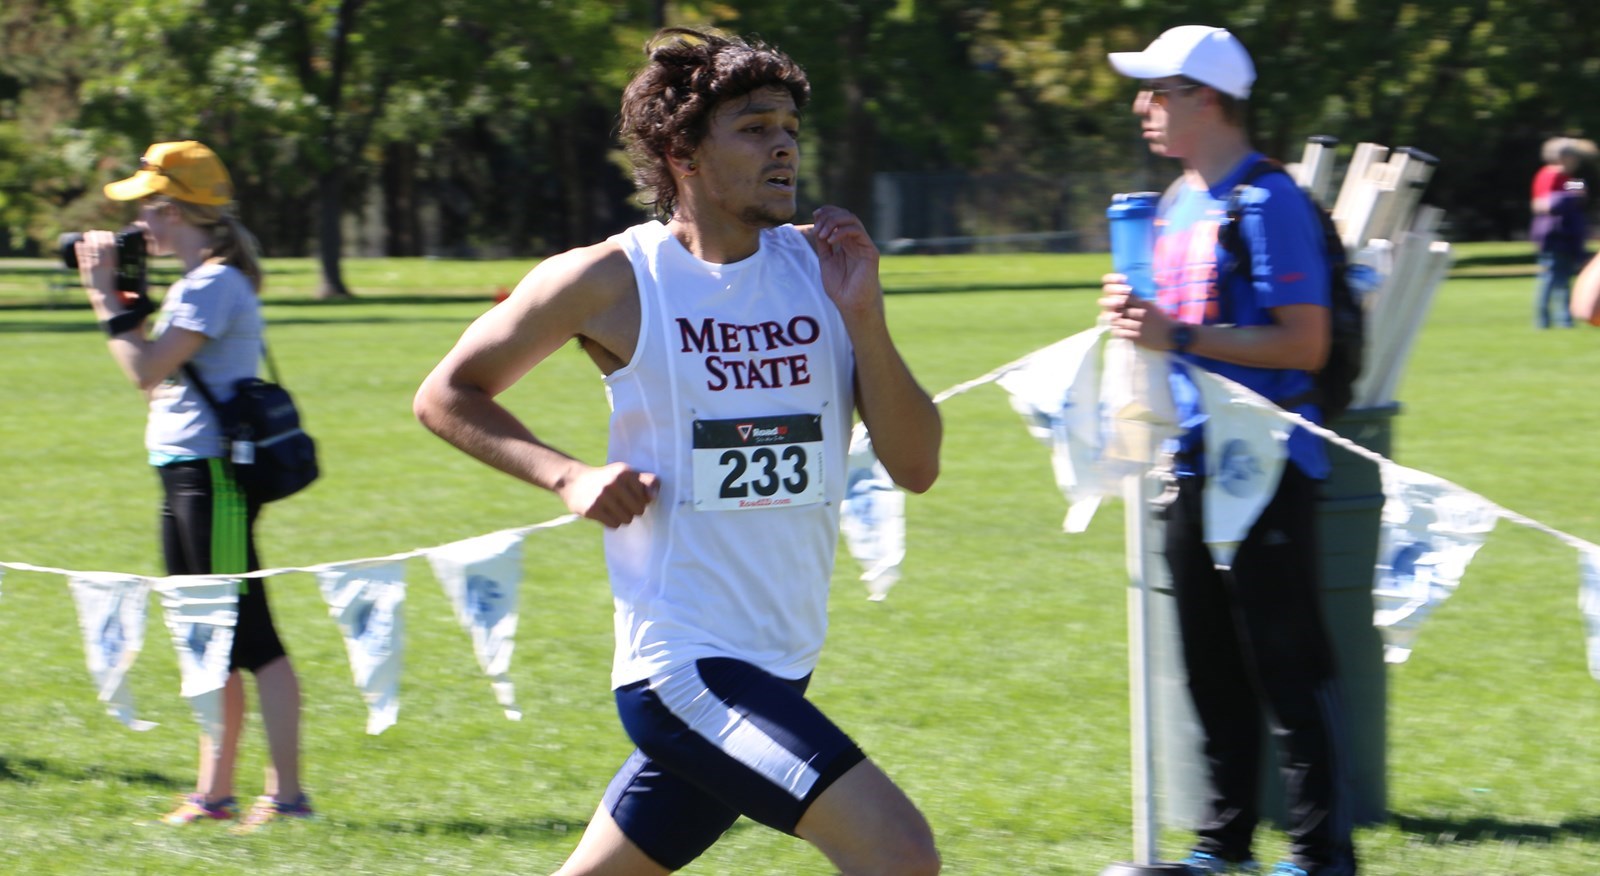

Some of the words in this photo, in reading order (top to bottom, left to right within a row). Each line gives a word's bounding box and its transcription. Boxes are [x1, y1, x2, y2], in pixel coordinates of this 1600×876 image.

[675, 315, 820, 353] METRO
[705, 354, 811, 391] STATE
[719, 445, 808, 499] 233
